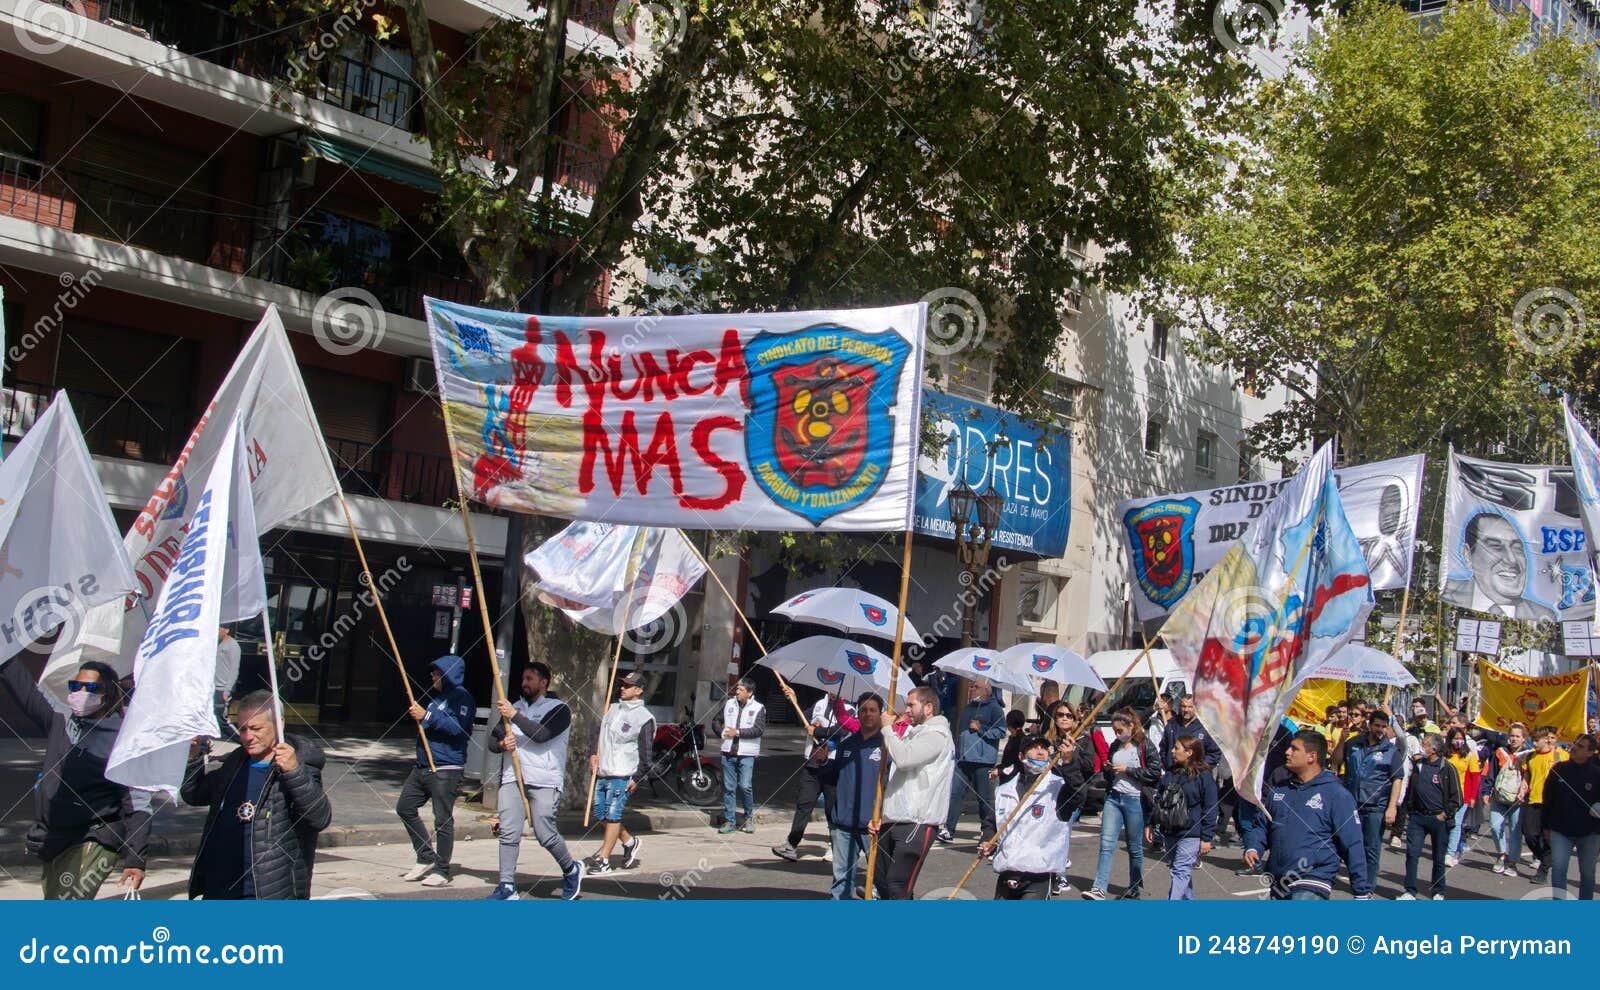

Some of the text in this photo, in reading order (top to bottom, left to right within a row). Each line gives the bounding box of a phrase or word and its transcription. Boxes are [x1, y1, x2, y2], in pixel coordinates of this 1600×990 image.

[553, 328, 749, 410] NUNCA
[757, 337, 815, 366] SINDICATO
[818, 336, 838, 350] DEL
[579, 408, 747, 511] MAS
[801, 492, 811, 507] Y
[810, 463, 881, 508] BALIZAMIENTO
[1003, 502, 1018, 515] LAZA
[1031, 507, 1049, 521] MAYO
